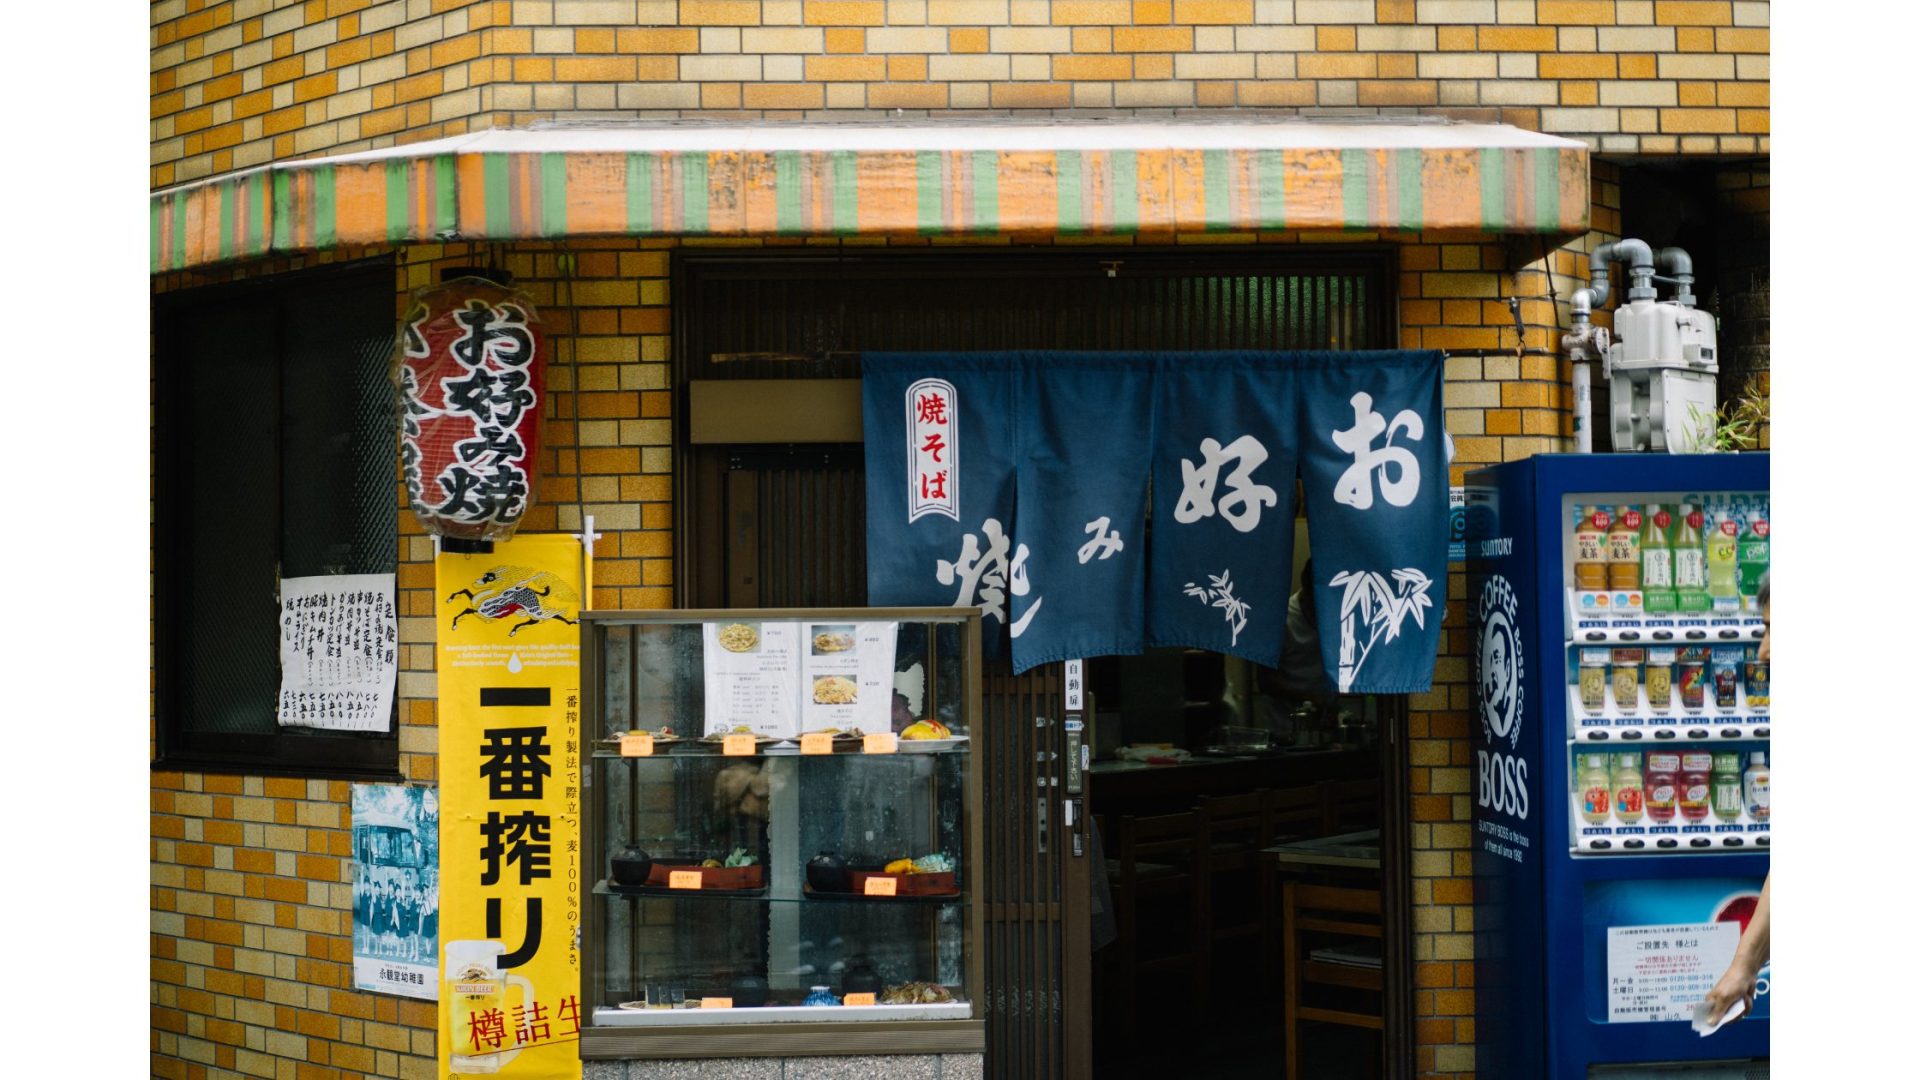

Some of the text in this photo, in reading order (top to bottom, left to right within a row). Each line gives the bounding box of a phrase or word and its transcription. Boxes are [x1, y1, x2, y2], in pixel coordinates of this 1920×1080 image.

[438, 298, 535, 524] お好み焼
[915, 393, 947, 501] 焼そば
[1481, 537, 1513, 556] SUNTORY
[1580, 548, 1598, 559] 麦茶
[1612, 548, 1630, 559] 麦茶
[1480, 574, 1518, 626] COFFEE
[1069, 664, 1079, 706] 自動扉
[1477, 749, 1528, 820] BOSS
[480, 687, 552, 970] 一番搾り
[1637, 939, 1699, 951] ご設置先 様とは
[379, 968, 424, 985] 永観堂幼稚園
[1613, 986, 1634, 994] 土曜日
[467, 995, 580, 1051] 樽詰生
